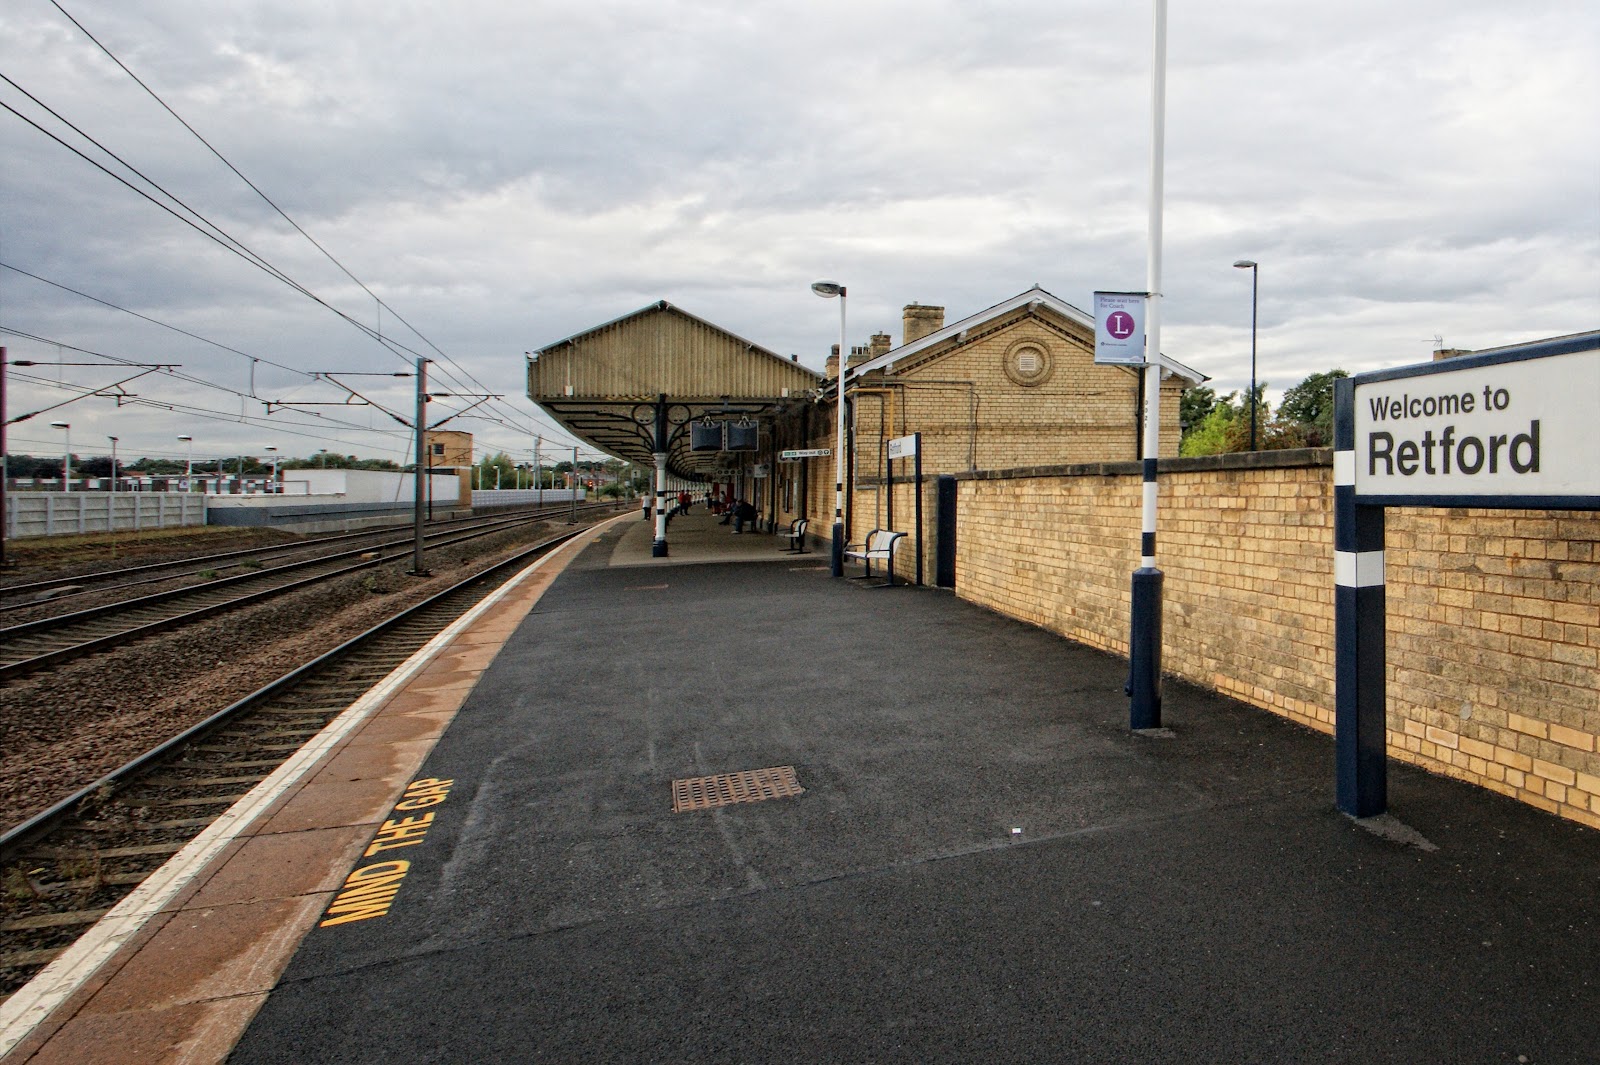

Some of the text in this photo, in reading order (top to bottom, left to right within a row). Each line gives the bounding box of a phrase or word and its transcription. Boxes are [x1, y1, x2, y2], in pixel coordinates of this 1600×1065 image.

[1114, 315, 1128, 334] L
[1369, 385, 1510, 421] Welcome to
[1369, 419, 1540, 476] Retford
[320, 778, 455, 928] MIND THE GAP
